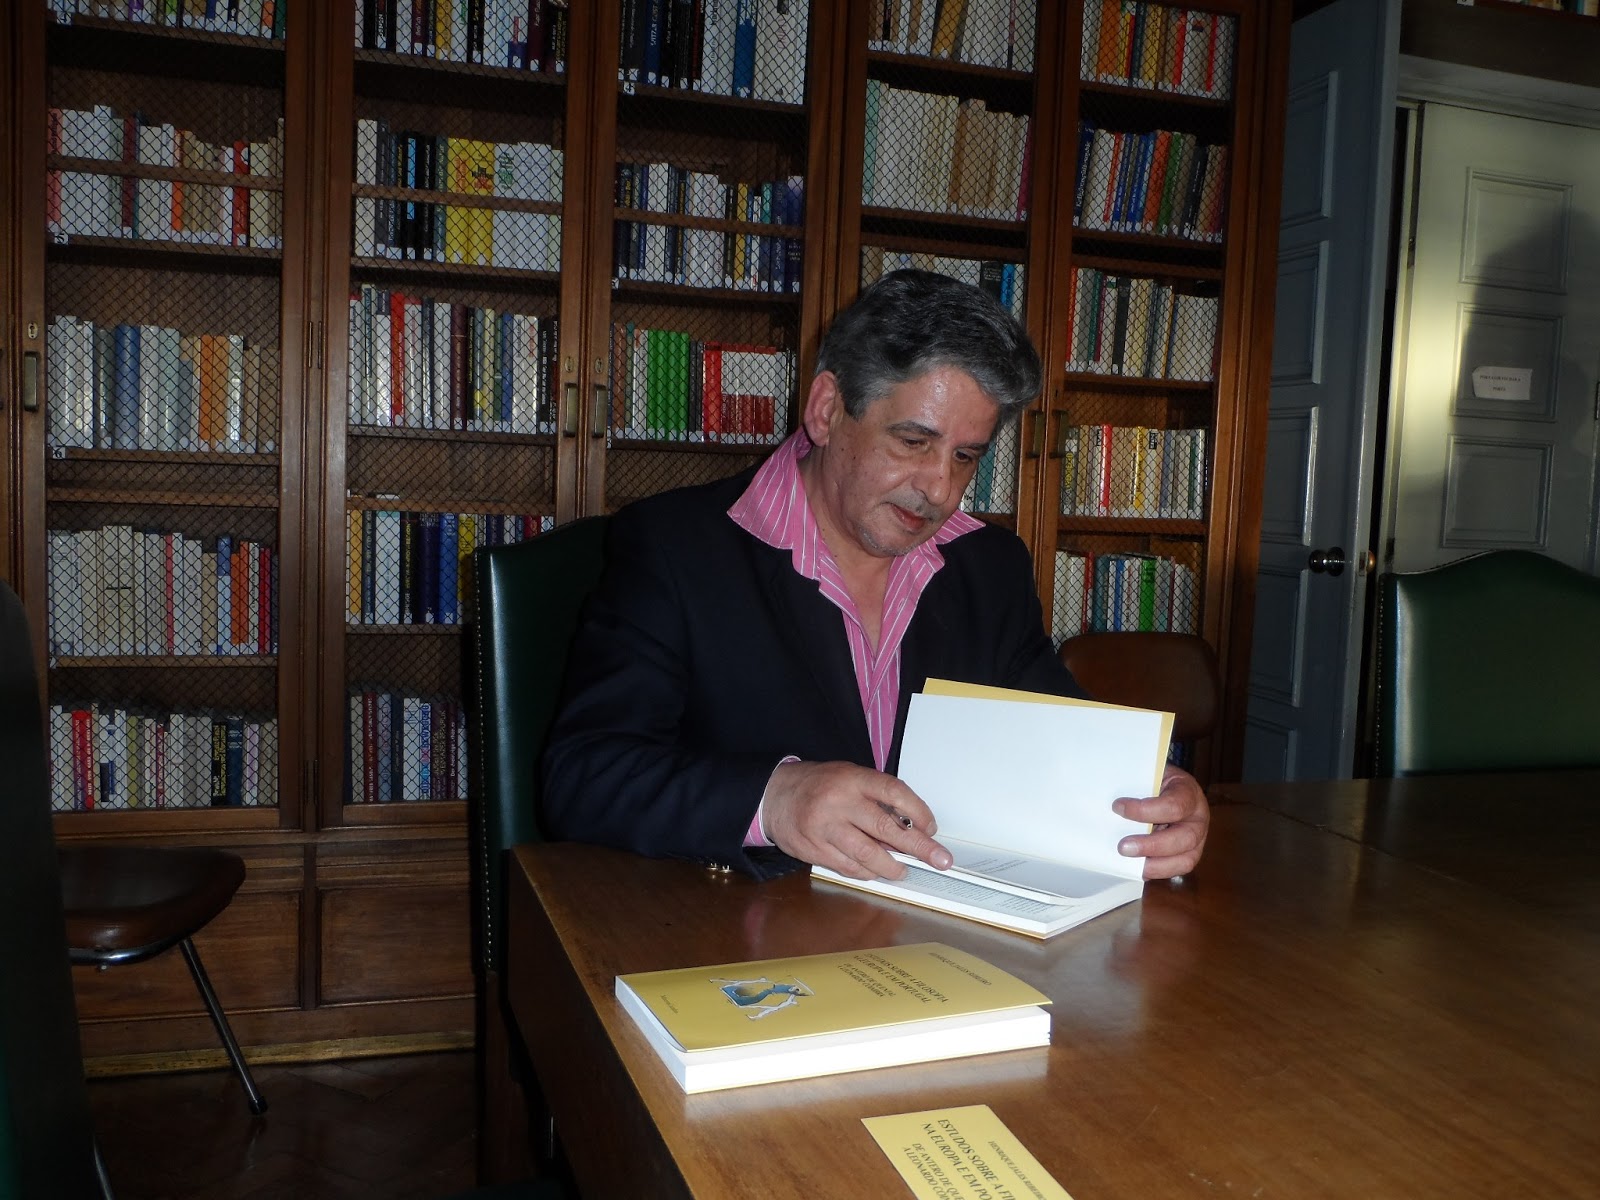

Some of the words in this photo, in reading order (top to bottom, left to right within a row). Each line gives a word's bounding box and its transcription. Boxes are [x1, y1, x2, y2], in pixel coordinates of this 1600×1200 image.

[906, 1151, 938, 1187] LEONARDO
[912, 1143, 926, 1154] DE
[921, 1153, 944, 1178] ANTERO
[940, 1176, 952, 1187] DE
[922, 1123, 935, 1135] NA
[931, 1135, 963, 1167] EUROPA
[963, 1174, 983, 1190] EM
[938, 1119, 975, 1154] ESTUDOS
[968, 1153, 998, 1181] SOBRE
[988, 1140, 1014, 1168] HENRIQUE
